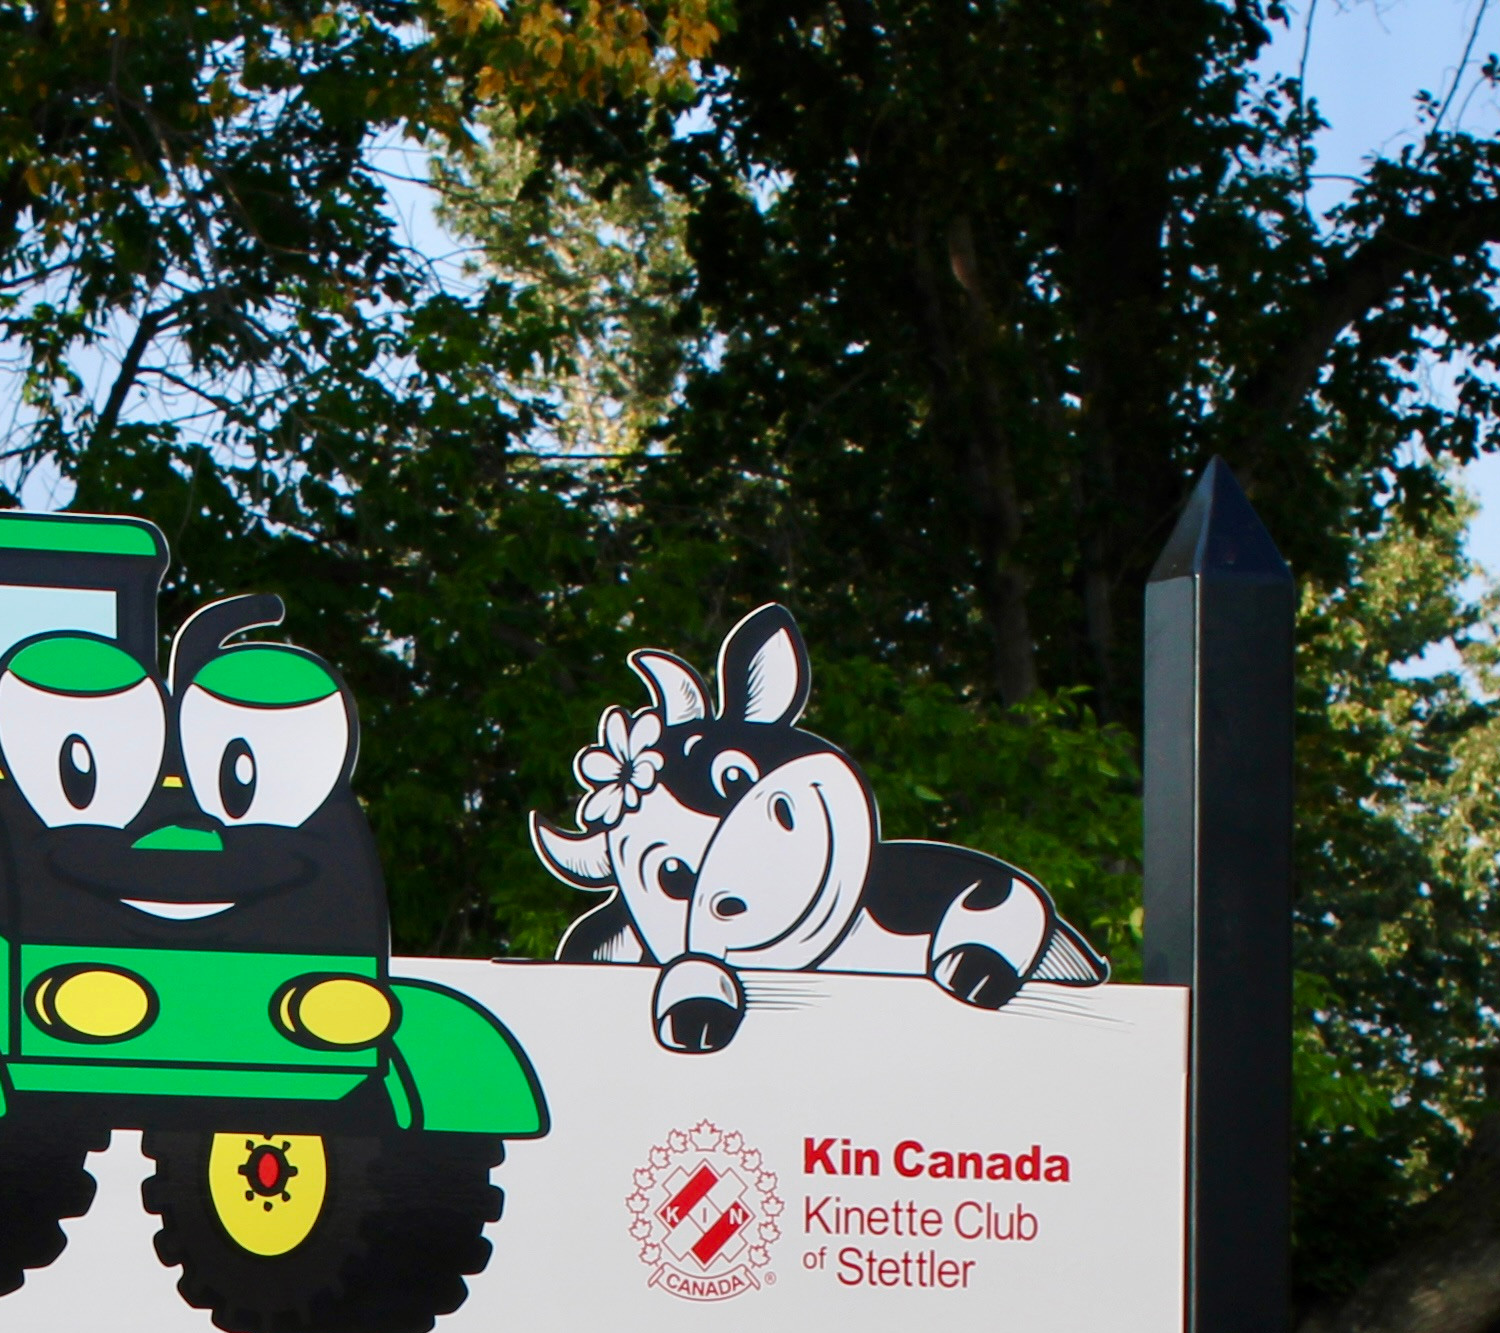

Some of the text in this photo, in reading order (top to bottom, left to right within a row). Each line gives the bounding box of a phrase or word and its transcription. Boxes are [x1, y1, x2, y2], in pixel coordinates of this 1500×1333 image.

[804, 1138, 1069, 1182] Kin Canada
[805, 1196, 1038, 1241] Kinette Club
[665, 1272, 746, 1298] CANADA
[803, 1246, 976, 1288] of Stettler
